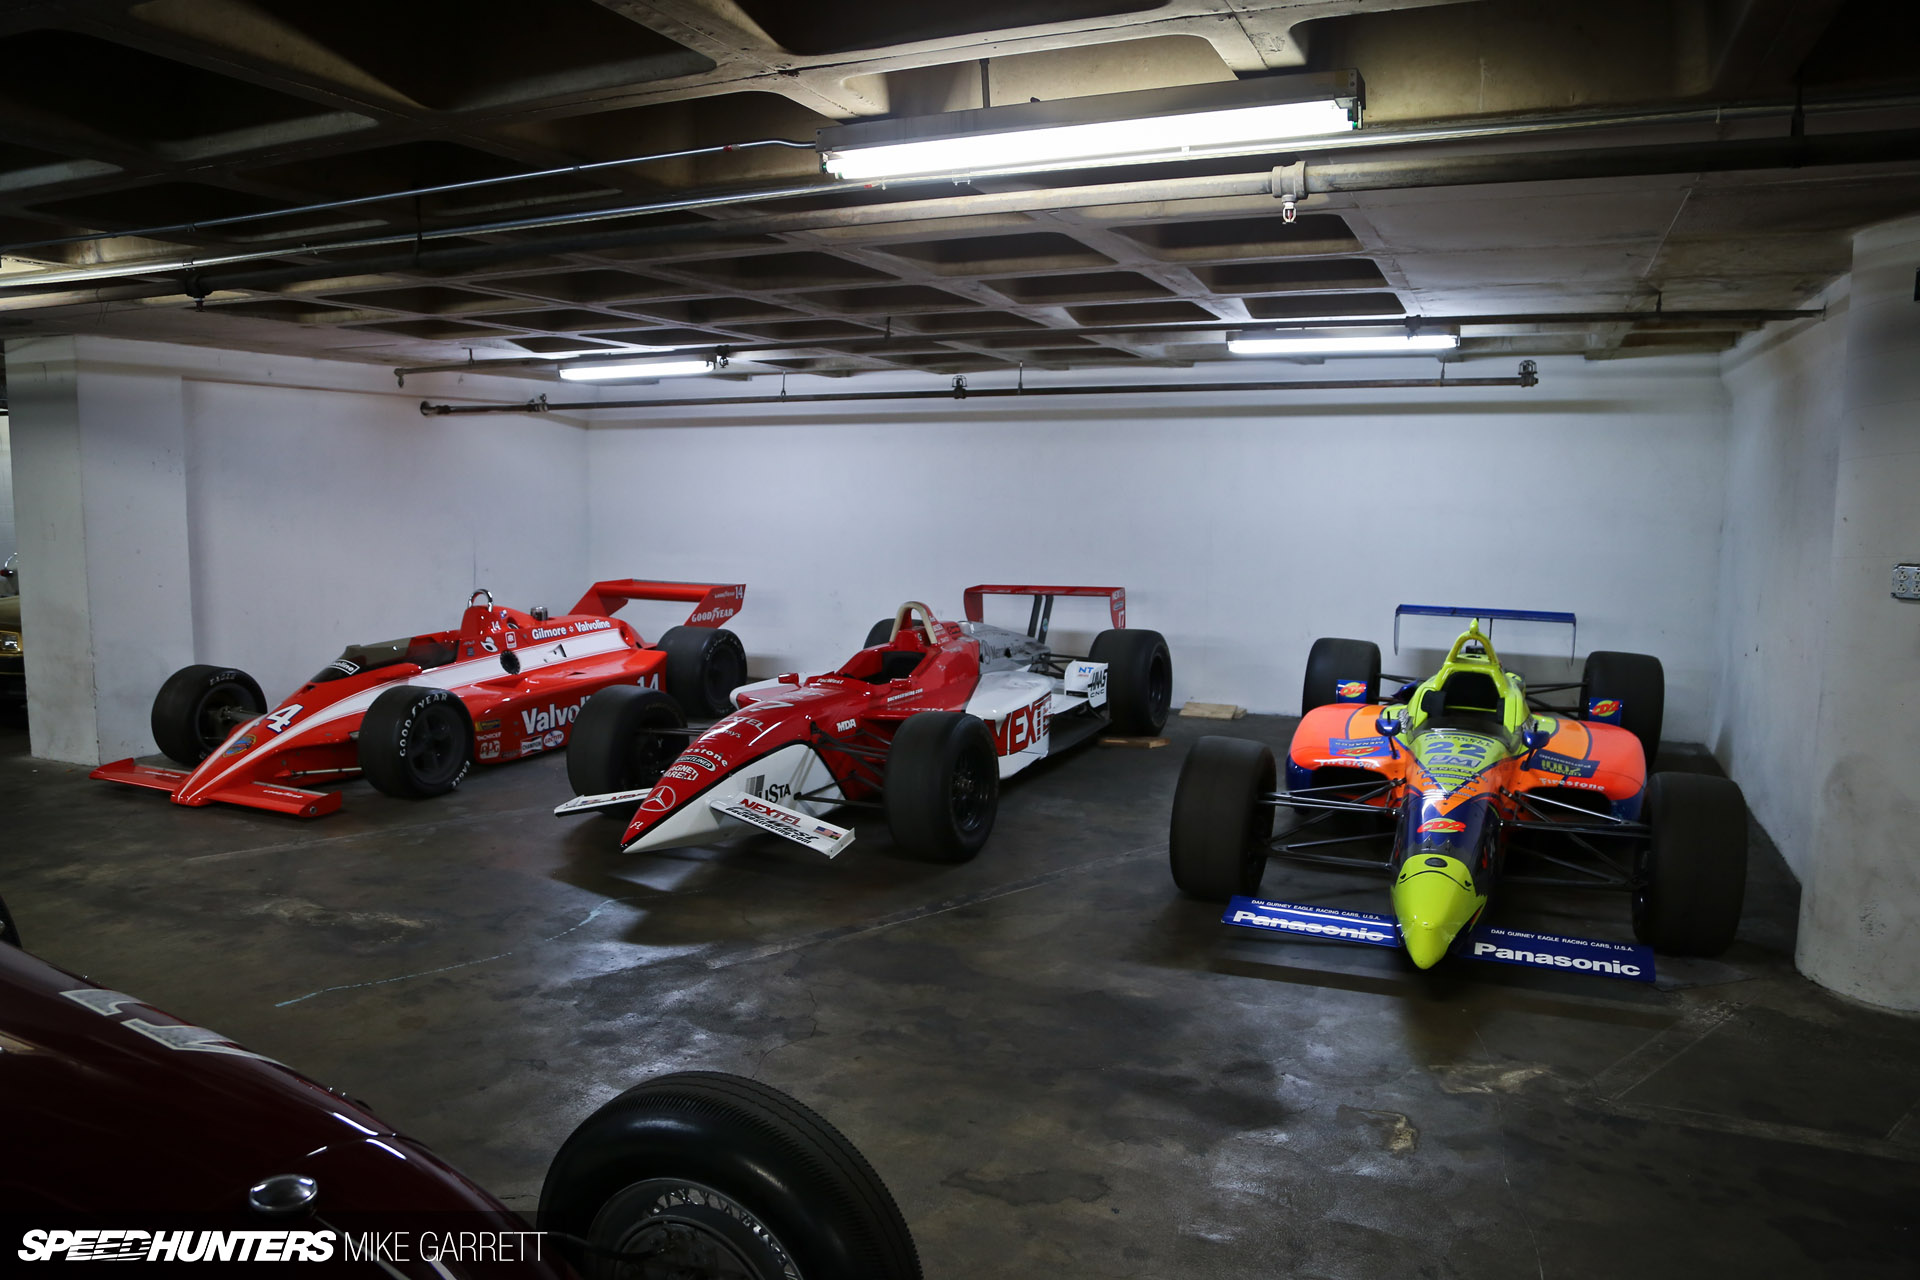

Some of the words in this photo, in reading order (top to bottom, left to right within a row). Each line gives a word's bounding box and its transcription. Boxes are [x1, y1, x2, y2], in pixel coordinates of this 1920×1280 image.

[735, 585, 743, 600] 14
[691, 607, 734, 623] GOODYEAR
[531, 626, 567, 640] Gilmore
[574, 619, 611, 633] Valvoline
[1090, 689, 1105, 698] CNC
[521, 695, 591, 735] Valvo
[1591, 701, 1620, 716] CD2
[399, 693, 448, 757] GOODYEAR
[836, 718, 857, 732] MDA
[1425, 741, 1487, 760] 22
[1539, 777, 1605, 791] Firestone
[739, 798, 802, 828] NEXTEL
[1416, 820, 1467, 833] CD2
[1266, 901, 1291, 909] GURNEY
[1293, 904, 1314, 912] EAGLE
[1232, 910, 1385, 942] Panasonic
[1507, 931, 1535, 939] GURNEY
[1537, 935, 1559, 943] EAGLE
[1562, 938, 1588, 946] RACING
[1473, 942, 1641, 976] Panasonic
